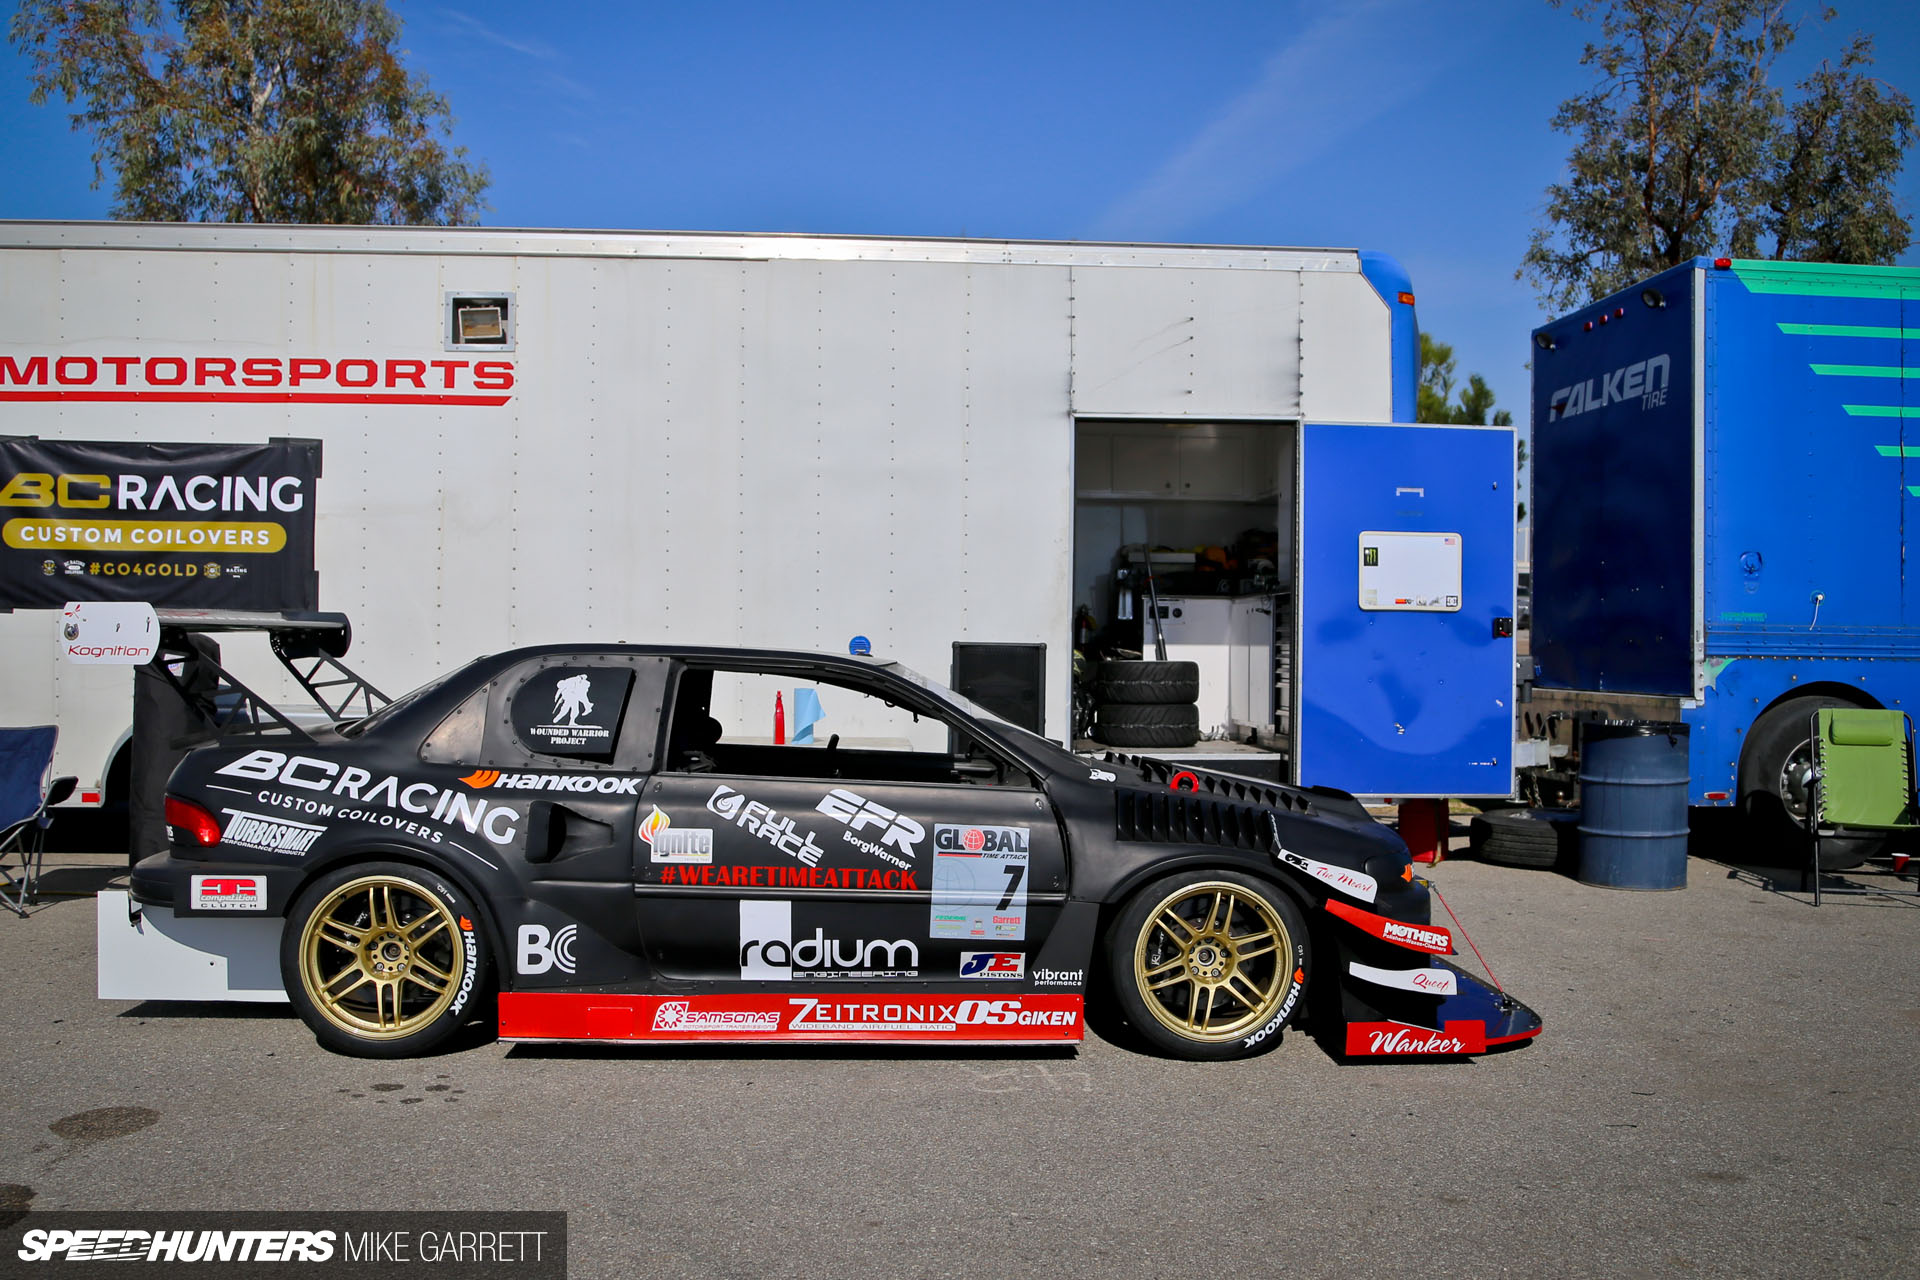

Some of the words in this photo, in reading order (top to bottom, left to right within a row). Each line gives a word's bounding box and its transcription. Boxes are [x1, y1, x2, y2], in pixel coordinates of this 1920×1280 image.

[0, 355, 515, 390] MOTORSPORTS
[1549, 353, 1671, 424] FALKEN
[1641, 387, 1667, 411] TIRE
[20, 525, 123, 545] CUSTOM
[129, 527, 270, 547] COILOVERS
[89, 562, 198, 577] #GO4GOLD
[68, 645, 150, 658] Kognition
[530, 727, 570, 737] WOUNDED
[571, 729, 610, 738] WARRIOR
[550, 737, 587, 745] PROJECT
[221, 807, 329, 852] TURBOSMART
[257, 790, 334, 818] CUSTOM
[337, 807, 444, 844] COILOVERS
[745, 800, 825, 854] FULL
[815, 788, 926, 858] EFR
[220, 837, 273, 853] PERFORMANCE
[273, 848, 306, 857] PRODUCTS
[653, 828, 711, 857] ignite
[736, 810, 823, 868] RACE
[842, 830, 912, 871] BorgWarner
[982, 852, 999, 860] TIME
[660, 865, 919, 890] #WEARETIMEATTACK
[995, 864, 1026, 911] 7
[200, 894, 257, 903] competition
[992, 915, 1021, 925] Garrett
[1383, 922, 1449, 947] MOTHERS
[740, 927, 919, 968] radium
[960, 952, 1023, 976] JE
[1033, 968, 1084, 980] vibrant
[1034, 979, 1083, 988] performance
[685, 1012, 780, 1024] SAMSONAS
[789, 998, 956, 1024] ZEITRONIX
[954, 1000, 1022, 1025] OS
[1017, 1010, 1077, 1026] GIKEN
[1368, 1028, 1466, 1054] Wanker
